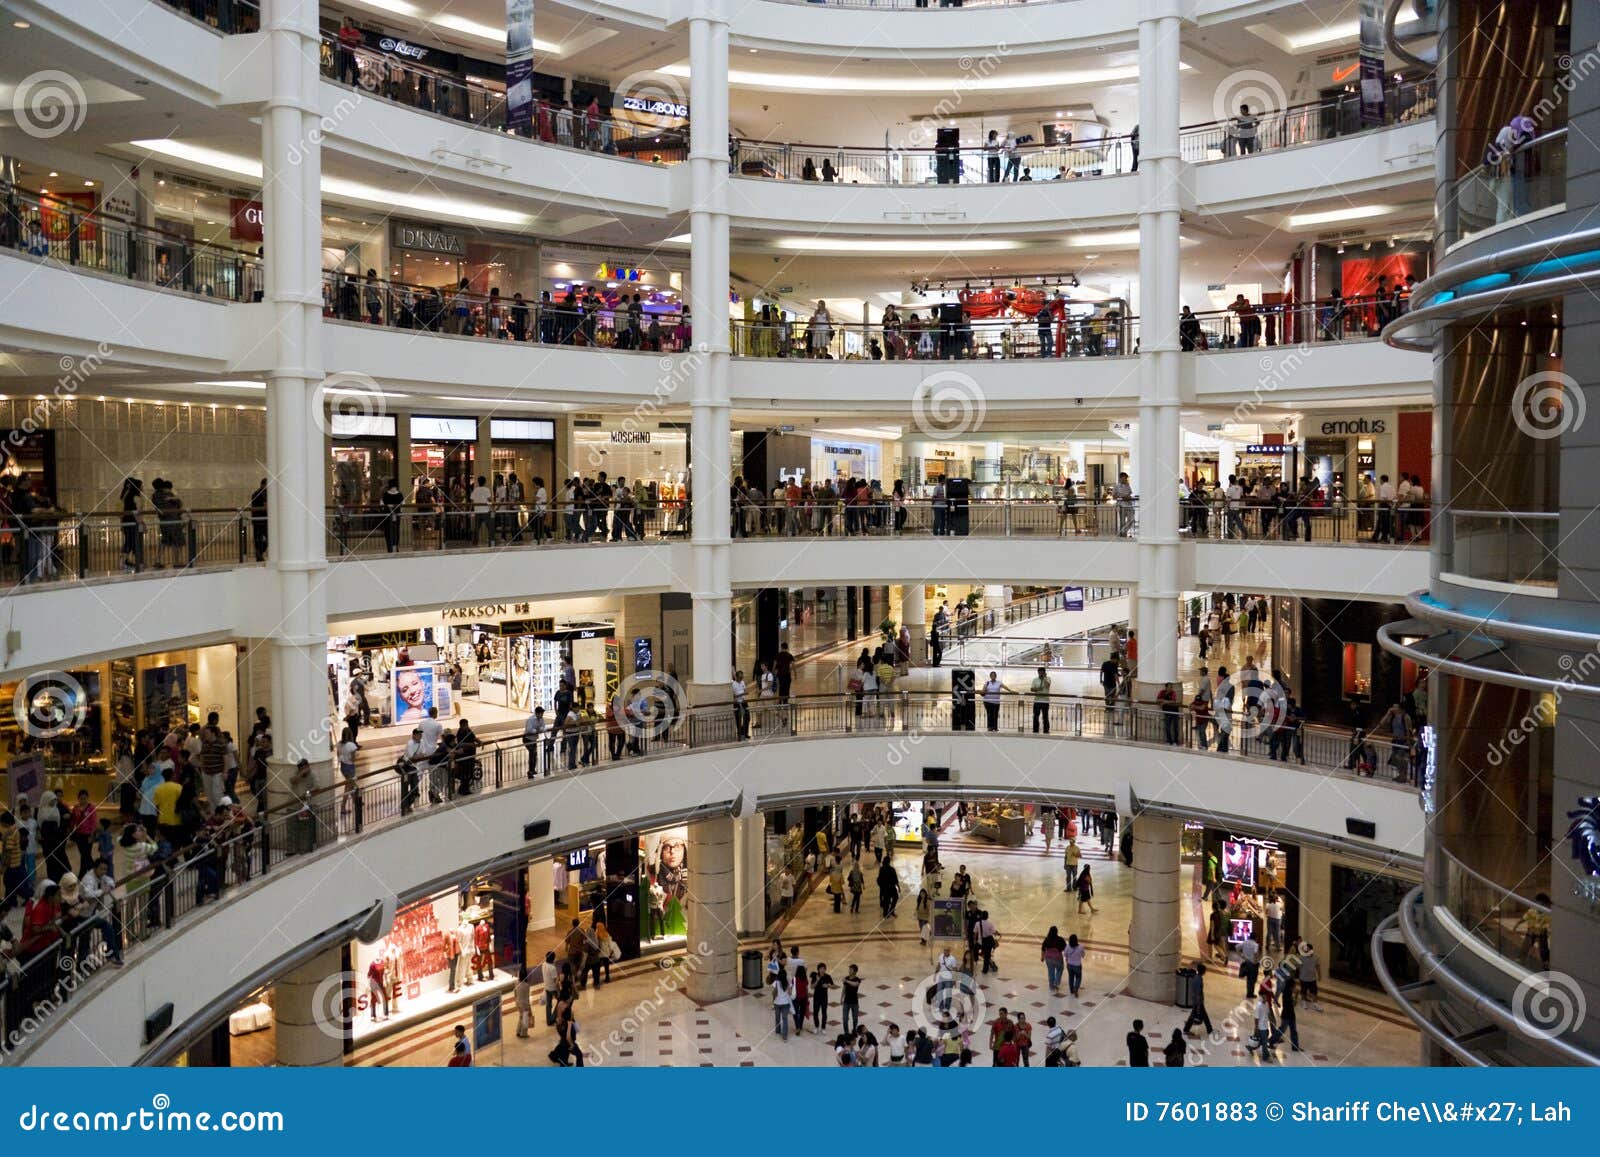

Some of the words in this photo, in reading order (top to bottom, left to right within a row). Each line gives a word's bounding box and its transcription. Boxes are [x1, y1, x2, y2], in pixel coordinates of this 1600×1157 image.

[402, 228, 461, 251] D'NATA
[1321, 417, 1385, 435] emotus
[610, 431, 651, 443] MOSCHINO
[442, 603, 507, 619] PARKSON
[522, 620, 550, 633] SALE
[581, 630, 595, 638] Dior
[382, 631, 414, 646] SALE
[569, 848, 587, 866] GAP
